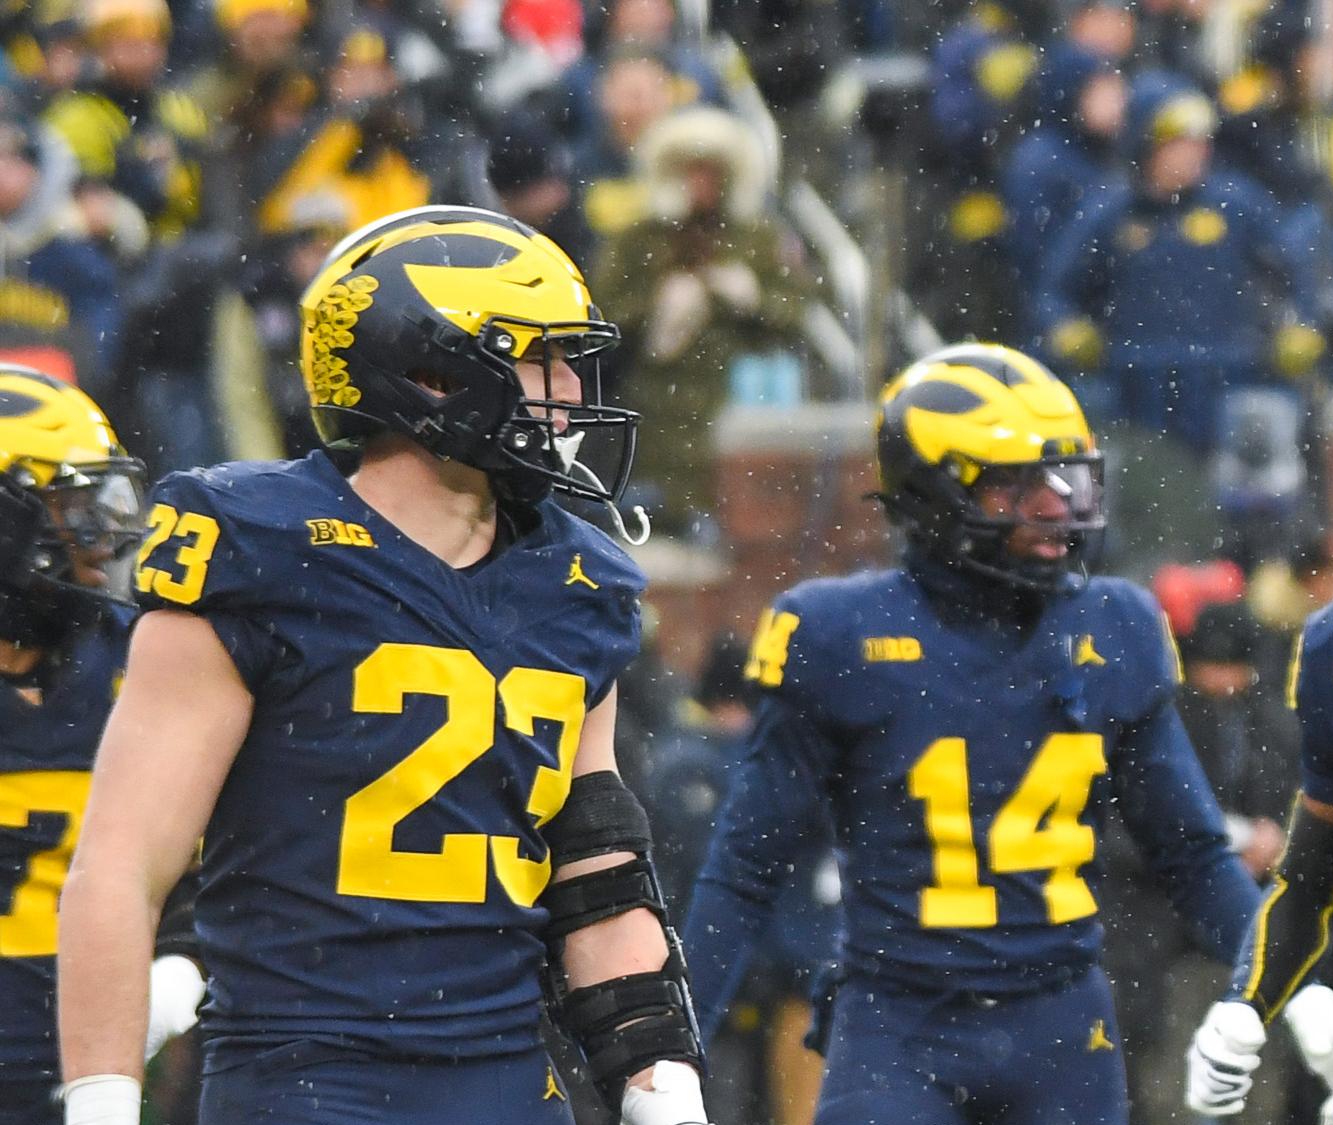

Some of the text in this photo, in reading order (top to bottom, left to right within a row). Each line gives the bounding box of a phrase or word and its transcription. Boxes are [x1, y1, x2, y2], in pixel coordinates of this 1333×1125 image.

[134, 503, 220, 605] 23
[336, 642, 587, 907] 23
[909, 732, 1109, 929] 14
